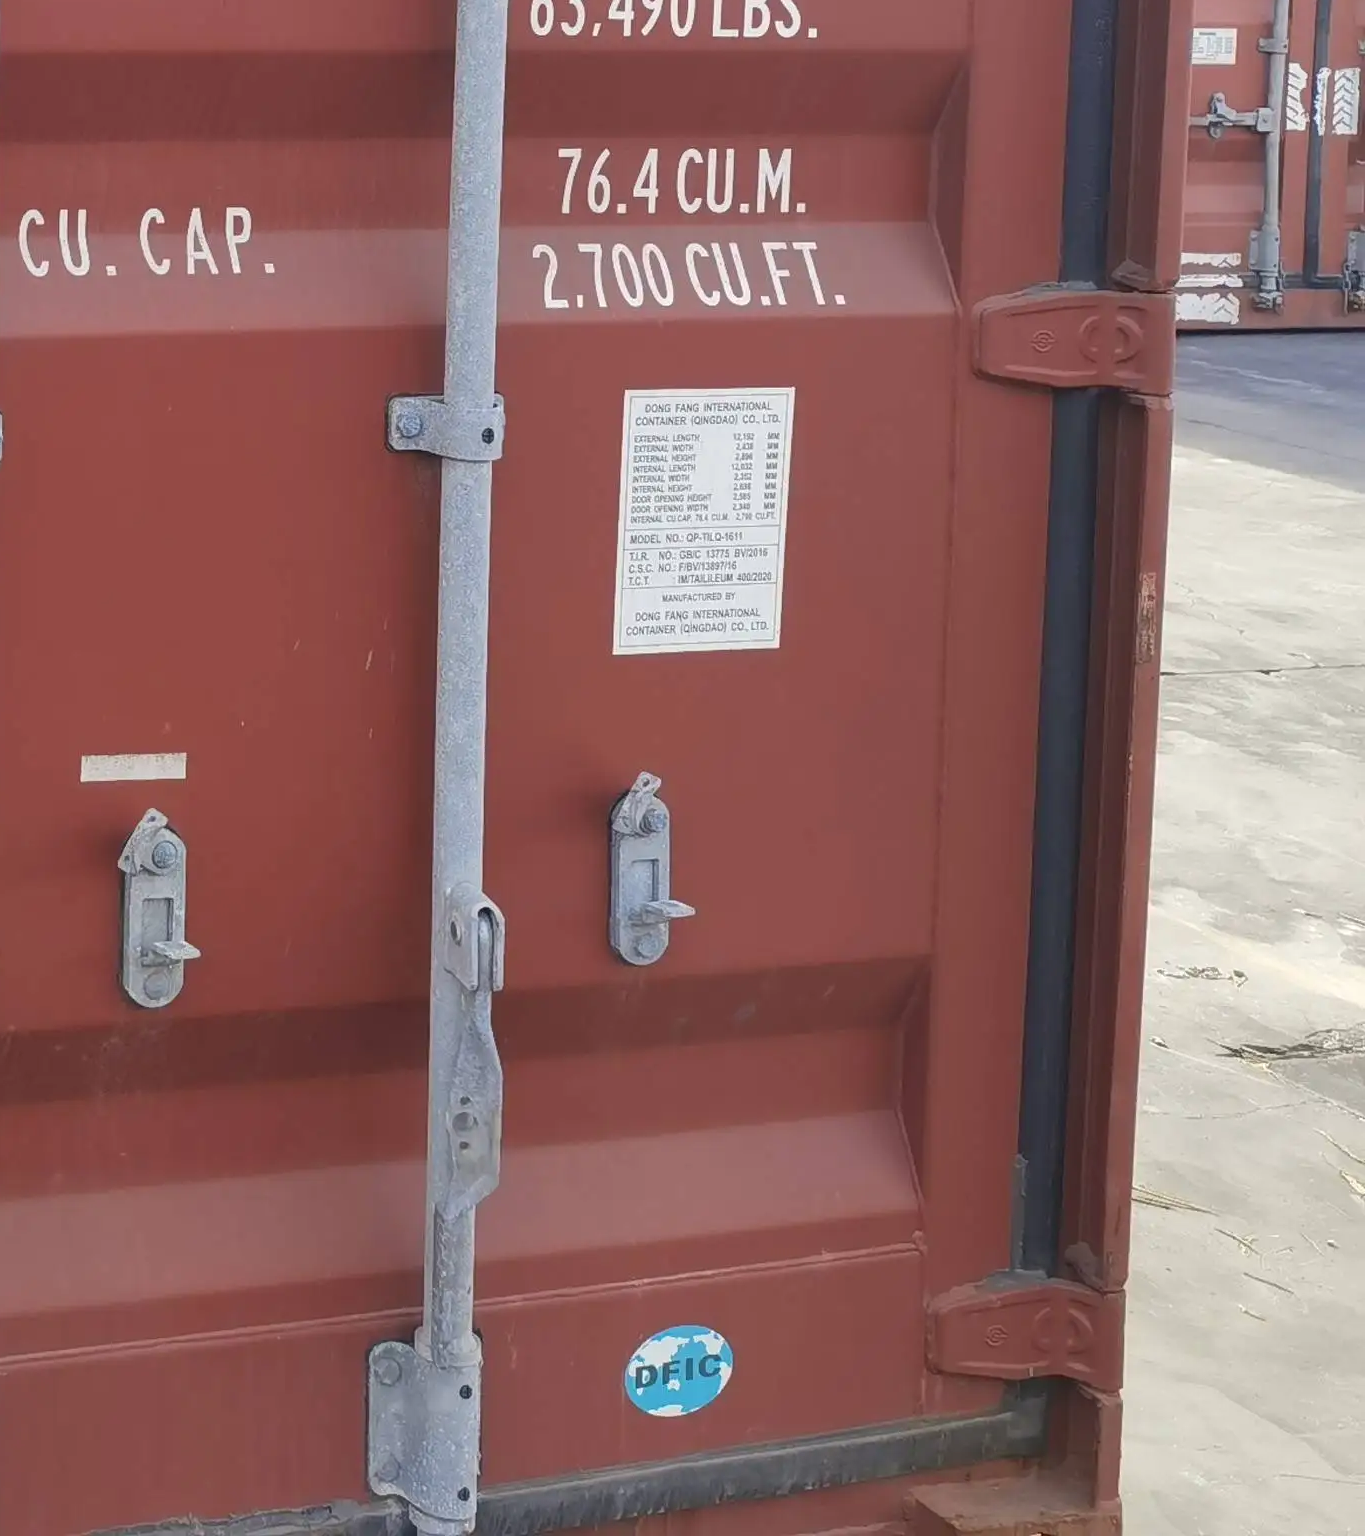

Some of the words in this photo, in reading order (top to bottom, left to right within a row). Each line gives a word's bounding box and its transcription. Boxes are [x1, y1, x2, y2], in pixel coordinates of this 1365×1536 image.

[558, 147, 659, 214] 76.4
[677, 147, 806, 214] CU.M.
[139, 207, 276, 275] CAP.
[685, 241, 846, 307] CU.FT.
[645, 404, 671, 413] DONG
[675, 403, 699, 413] FANG
[704, 401, 773, 412] INTERNATIONAL
[635, 416, 687, 426] CONTAINER
[691, 415, 738, 426] (QINGDAO)
[762, 414, 781, 424] LTD.
[629, 534, 661, 544] MODEL
[706, 549, 730, 558] 13775
[662, 592, 722, 602] MANUFACTURED
[725, 591, 736, 600] BY
[635, 611, 660, 622] DONG
[665, 610, 689, 621] FANG
[692, 608, 761, 619] INTERNATIONAL
[626, 625, 676, 636] CONTAINER
[680, 622, 727, 635] (QINGDAO)
[751, 621, 769, 631] LTD.
[635, 1353, 722, 1389] DFIC
